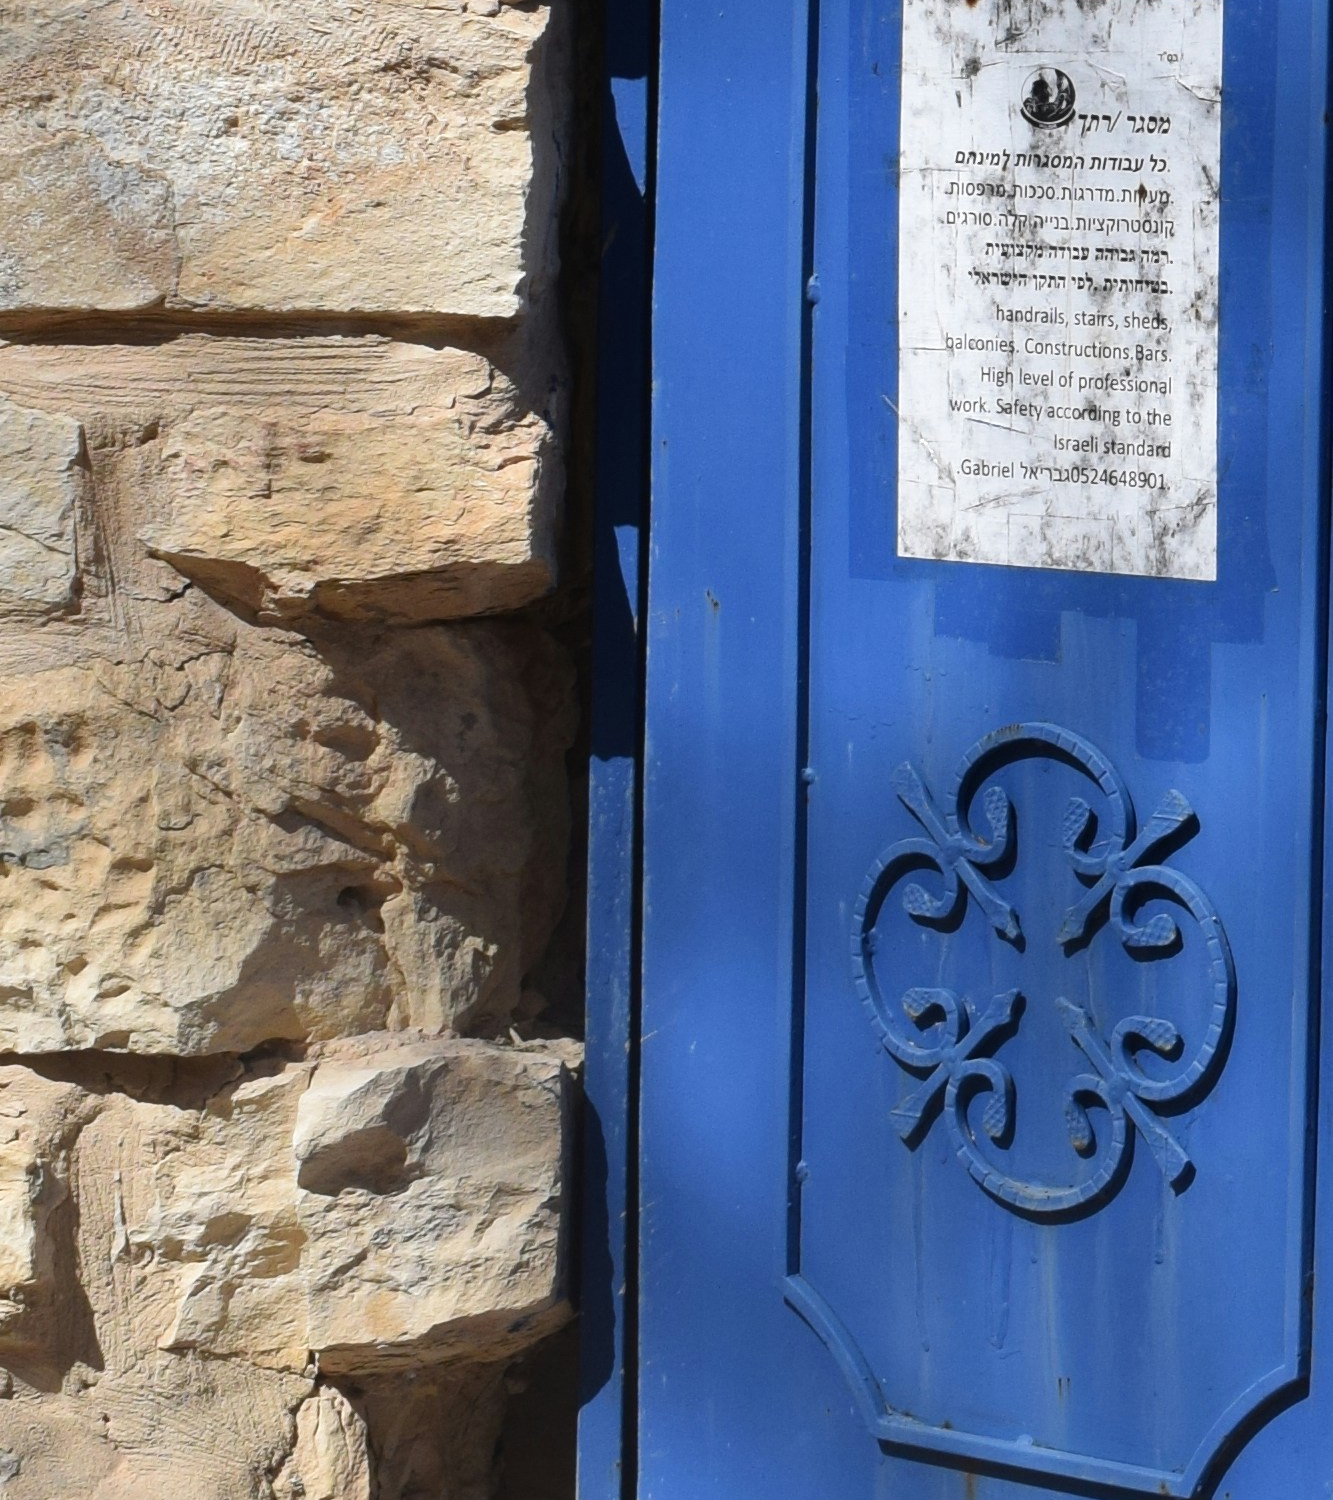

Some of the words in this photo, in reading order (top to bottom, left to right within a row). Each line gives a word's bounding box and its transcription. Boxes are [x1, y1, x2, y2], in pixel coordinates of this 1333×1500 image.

[1126, 115, 1172, 135] מסגר
[954, 148, 1010, 169] למינהם
[1014, 152, 1085, 171] המסגרות
[1089, 155, 1144, 173] עבודות
[985, 242, 1044, 261] מקצועית
[1048, 245, 1090, 261] עבודה
[1094, 247, 1136, 262] גבוהה
[967, 266, 1028, 288] הישראלי
[1032, 274, 1066, 291] התקן
[996, 304, 1070, 328] handrails,
[1074, 310, 1119, 331] stairs,
[1123, 311, 1173, 334] sheds,
[945, 332, 1020, 354] balconies.
[980, 366, 1014, 388] High
[1019, 368, 1054, 387] level
[1058, 370, 1075, 388] of
[1078, 372, 1173, 396] professional
[949, 397, 992, 414] work.
[996, 397, 1043, 422] Safety
[1046, 403, 1121, 427] according
[1125, 407, 1142, 425] to
[1146, 408, 1173, 427] the
[1053, 433, 1099, 454] Israeli
[1102, 436, 1172, 459] standard
